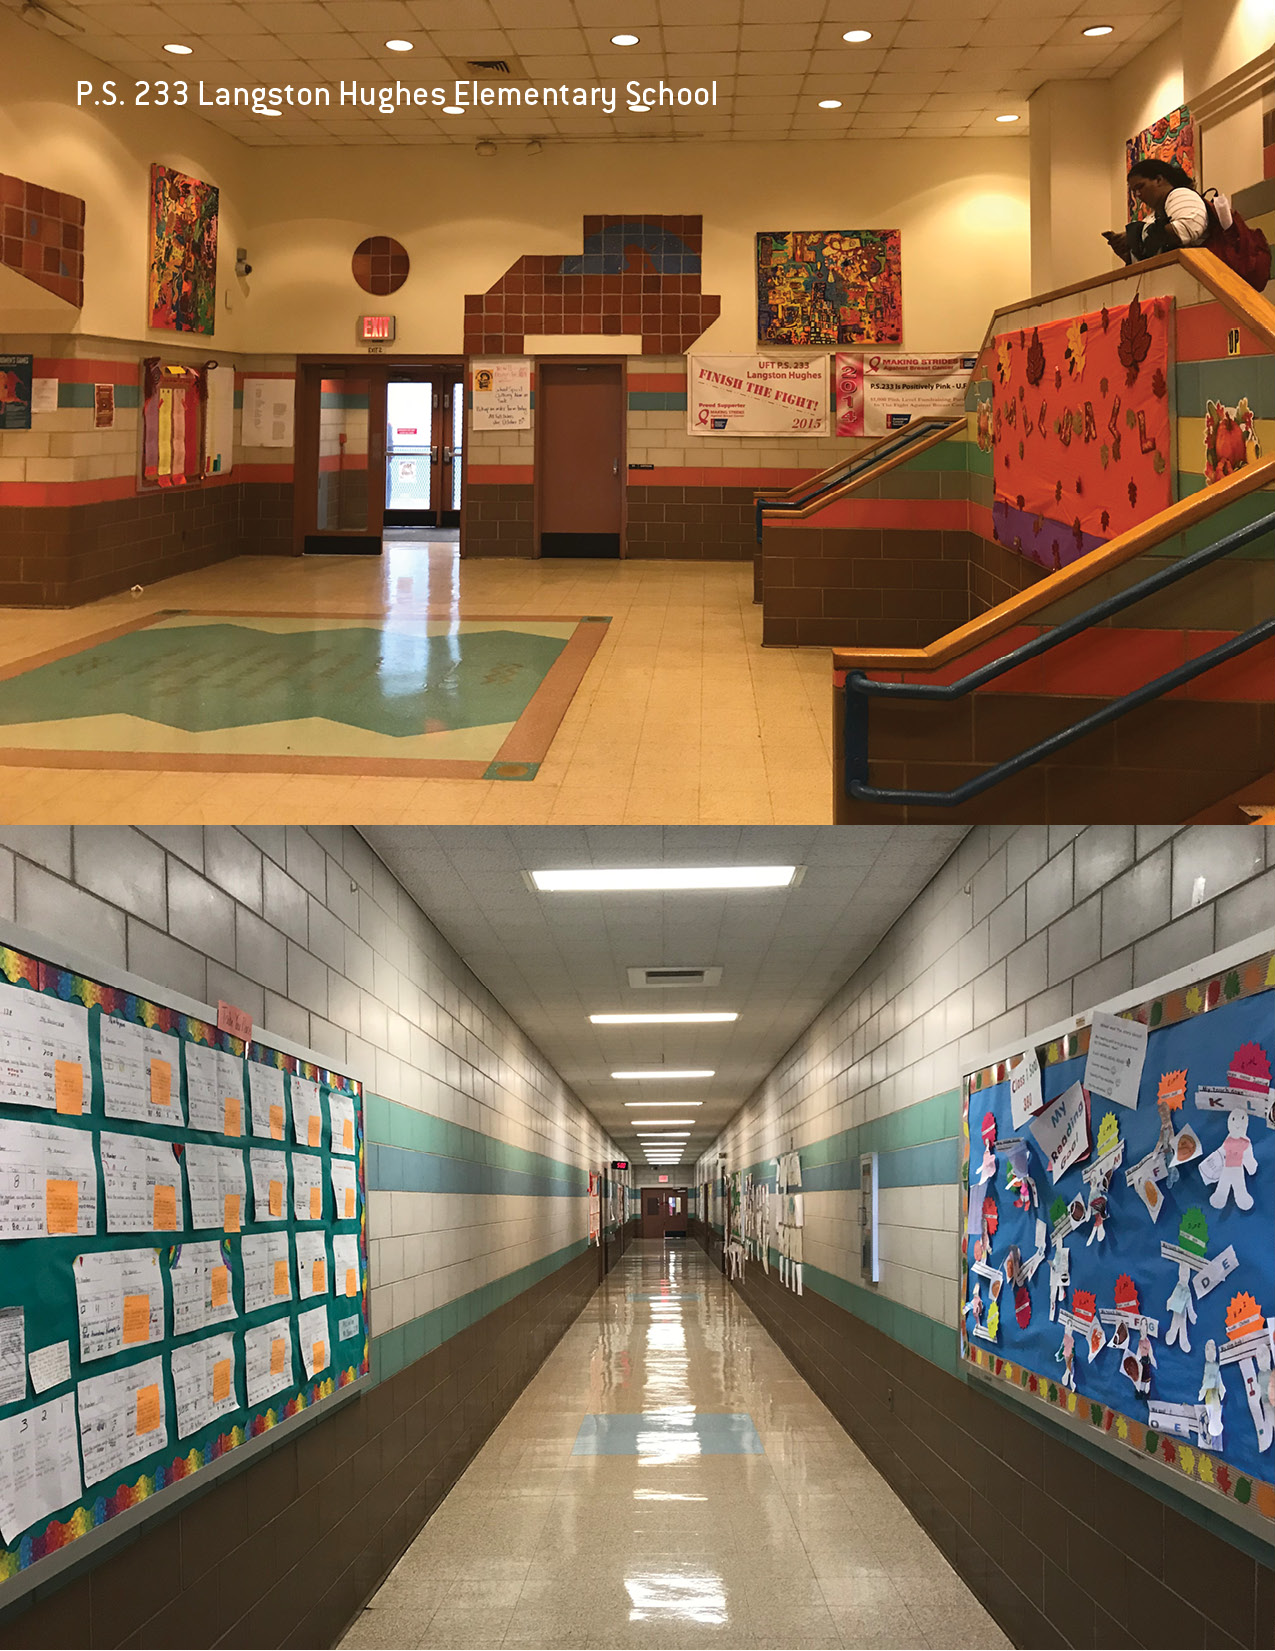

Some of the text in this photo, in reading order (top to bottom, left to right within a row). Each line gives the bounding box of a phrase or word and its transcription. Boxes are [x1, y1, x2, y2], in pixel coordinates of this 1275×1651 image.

[364, 317, 390, 337] EXIT
[1228, 329, 1239, 353] UP
[747, 372, 822, 380] Langston Hughes
[699, 369, 819, 411] FINISH THE FIGHT!
[792, 418, 822, 429] 2015
[1051, 1101, 1066, 1128] My
[1209, 1098, 1256, 1111] K L
[1051, 1101, 1083, 1162] Reading
[1060, 1132, 1078, 1170] Goal
[1202, 1259, 1230, 1288] D E
[20, 1419, 28, 1433] 3
[41, 1410, 47, 1421] 2
